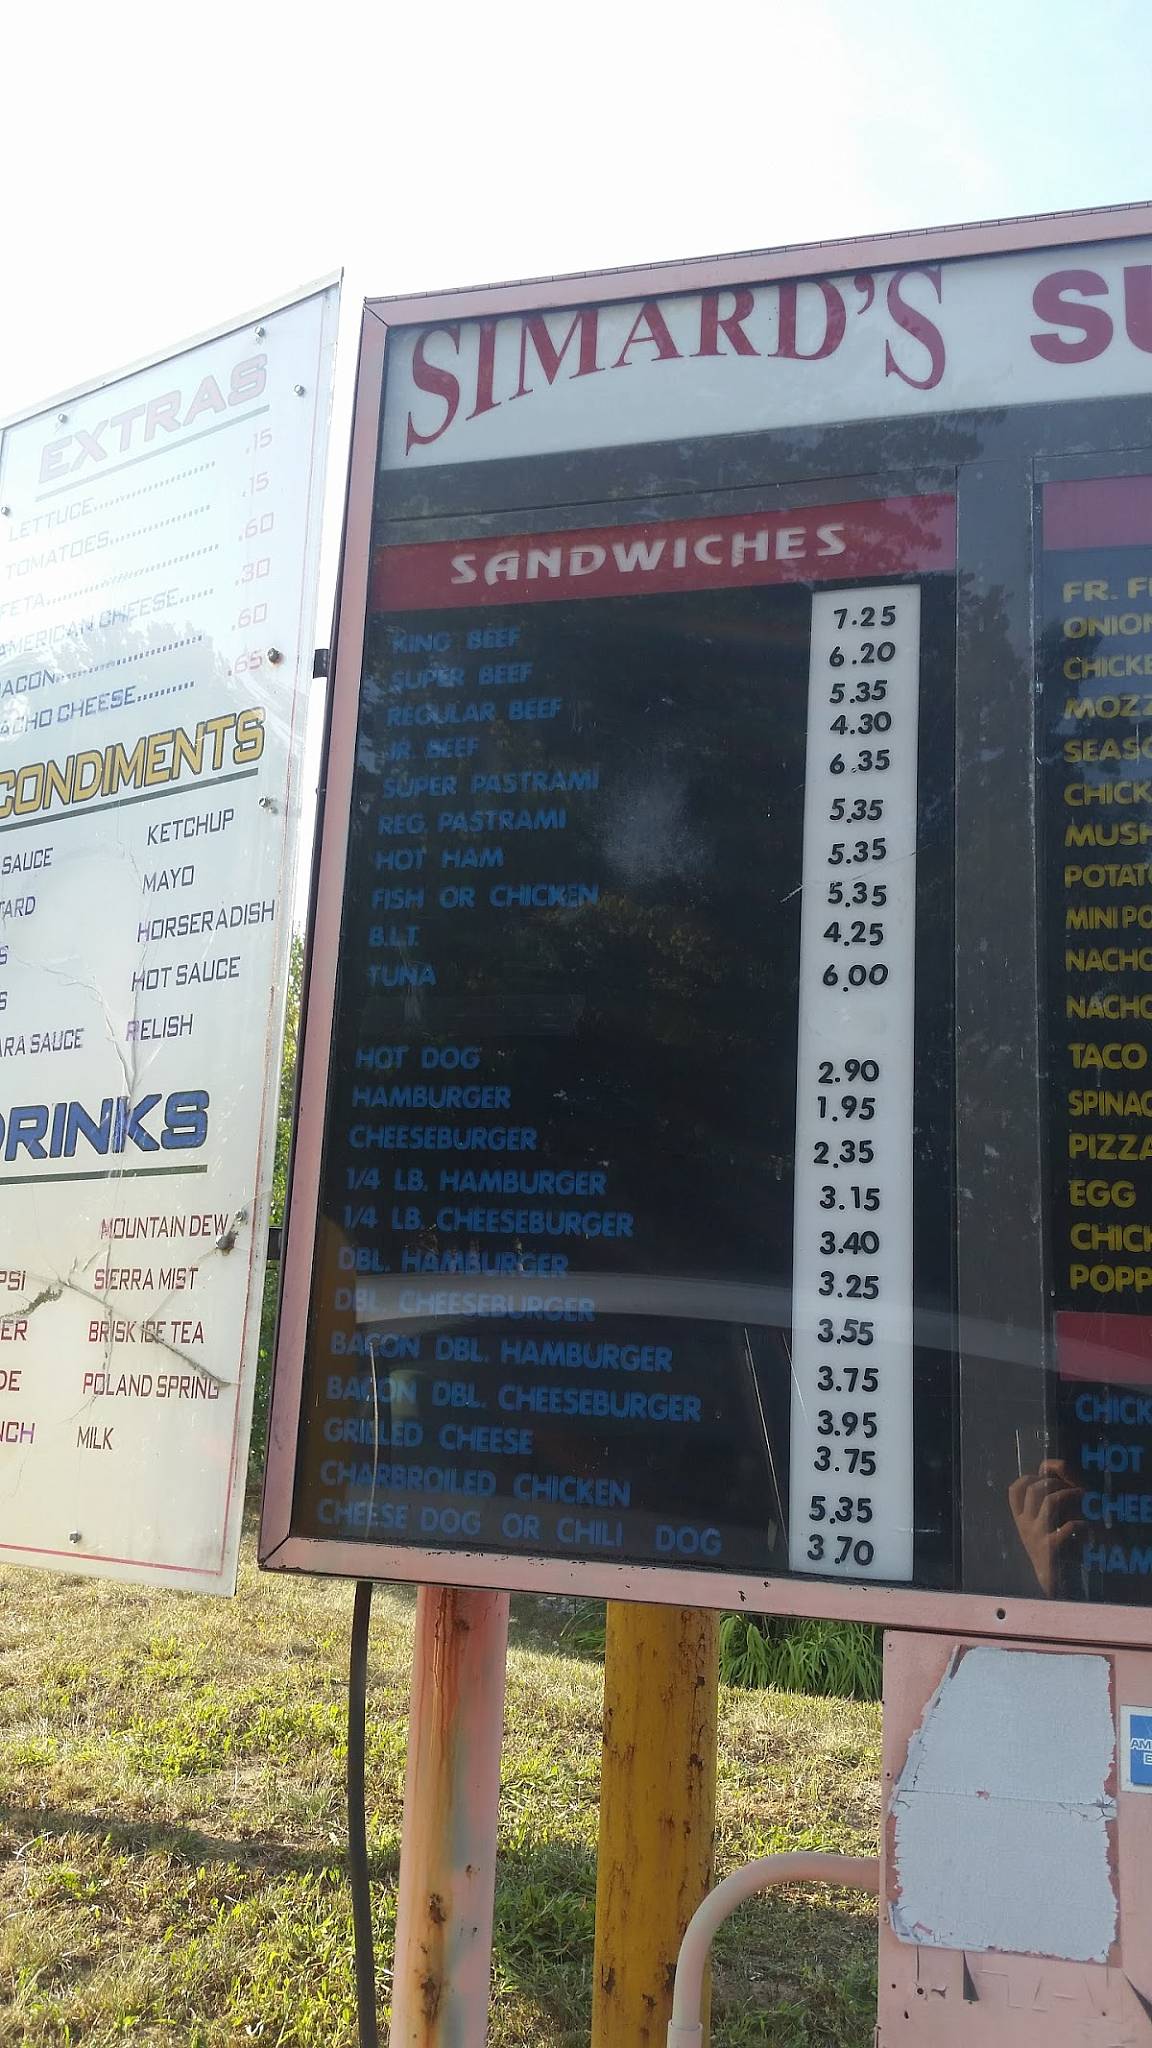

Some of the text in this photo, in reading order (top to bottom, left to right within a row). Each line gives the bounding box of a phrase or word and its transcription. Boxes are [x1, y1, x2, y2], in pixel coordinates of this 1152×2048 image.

[405, 262, 946, 457] SIMARD'S
[38, 353, 268, 484] EXTRAS
[245, 427, 272, 454] .15
[242, 471, 269, 497] .15
[450, 522, 847, 586] SANDWICHES
[235, 558, 270, 585] .30
[1062, 579, 1119, 604] FR.
[232, 603, 267, 631] .60
[834, 606, 897, 629] 7.25
[391, 626, 521, 652] KING BEEF
[829, 641, 896, 667] 6.20
[390, 662, 533, 692] SUPER BEEF
[829, 680, 888, 704] 5.35
[386, 698, 562, 727] REGULAR BEEF
[830, 711, 892, 735] 4.30
[425, 736, 480, 759] BEEF
[829, 749, 890, 774] 6.35
[383, 768, 600, 799] SUPER PASTRAMI
[436, 808, 567, 833] PASTRAMI
[829, 798, 884, 823] 5.35
[147, 808, 234, 846] KETCHUP
[1, 848, 53, 875] SAUCE
[374, 847, 504, 871] HOT HAM
[828, 838, 887, 865] 5.35
[142, 865, 195, 894] MAYO
[370, 883, 599, 910] FISH OR CHICKEN
[828, 881, 887, 907] 5.35
[137, 900, 275, 943] HORSERADISH
[1065, 906, 1119, 930] MINI
[823, 921, 884, 946] 4.25
[131, 956, 241, 992] HOT SAUCE
[367, 961, 437, 987] TUNA
[822, 963, 889, 992] 6.00
[30, 1028, 84, 1054] SAUCE
[125, 1014, 193, 1042] RELISH
[355, 1046, 482, 1069] HOT DOG
[1067, 1043, 1148, 1070] TACO
[818, 1059, 880, 1084] 2.90
[351, 1085, 512, 1109] HAMBURGER
[817, 1095, 876, 1122] 1.95
[349, 1124, 538, 1151] CHEESEBURGER
[813, 1140, 875, 1168] 2.35
[346, 1167, 608, 1195] 1/4 LB. HAMBURGER
[1069, 1180, 1137, 1208] EGG
[819, 1186, 880, 1211] 3.15
[101, 1213, 229, 1239] MOUNTAIN DEW
[343, 1205, 378, 1229] 1/4
[436, 1207, 635, 1238] CHEESEBURGER
[819, 1231, 880, 1255] 3.40
[401, 1249, 570, 1279] HAMBURGER
[94, 1267, 199, 1290] SIERRA MIST
[818, 1271, 879, 1299] 3.25
[400, 1288, 596, 1322] CHEESEBURGER
[88, 1320, 204, 1344] BRISK ICE TEA
[817, 1319, 874, 1346] 3.55
[331, 1331, 673, 1373] BACON DBL. HAMBURGER
[83, 1372, 219, 1400] POLAND SPRING
[817, 1366, 879, 1392] 3.75
[327, 1375, 702, 1422] BACON DBL. CHEESEBURGER
[76, 1425, 114, 1450] MILK
[323, 1416, 534, 1455] GRILLED CHEESE
[817, 1410, 877, 1438] 3.95
[813, 1446, 877, 1476] 3.75
[1080, 1442, 1144, 1473] HOT
[320, 1459, 631, 1507] CHARBROILED CHICKEN
[808, 1494, 873, 1524] 5.35
[318, 1499, 722, 1556] CHEESE DOG OR CHILI DOG
[806, 1534, 875, 1566] 3.70
